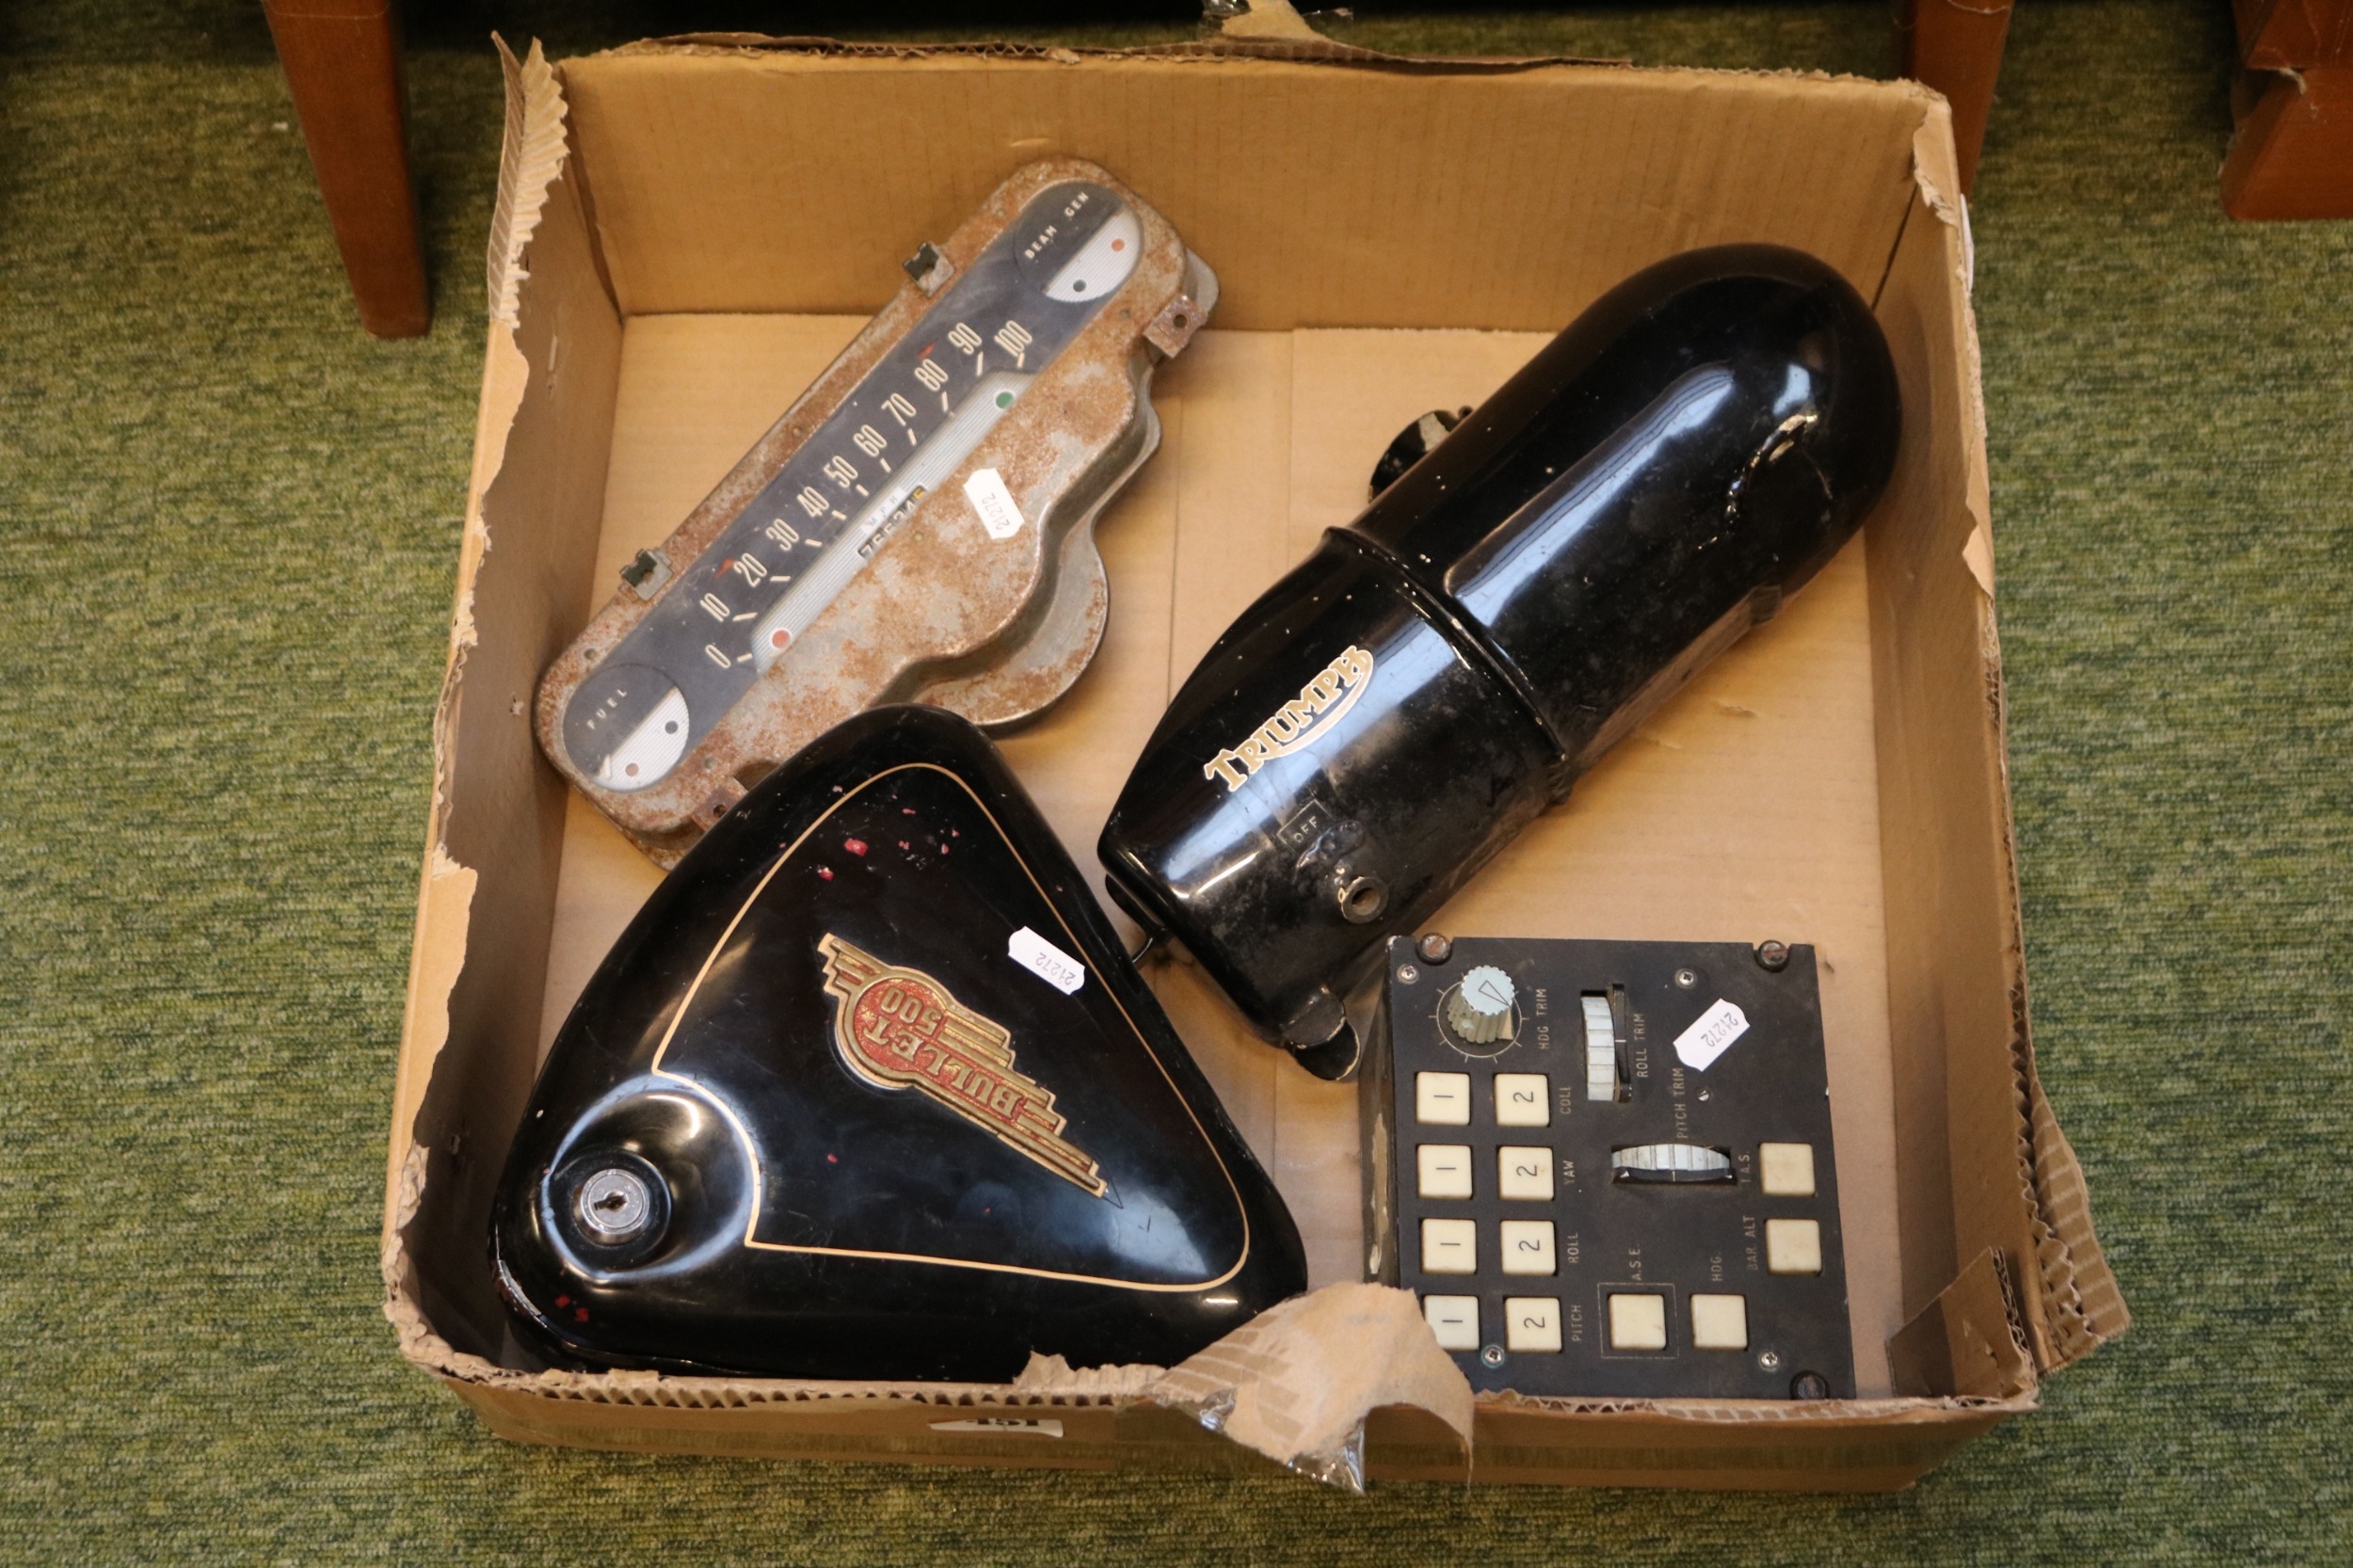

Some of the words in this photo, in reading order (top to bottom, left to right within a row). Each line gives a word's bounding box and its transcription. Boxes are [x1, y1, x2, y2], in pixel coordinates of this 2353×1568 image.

[1064, 191, 1089, 216] GEN
[1023, 225, 1057, 259] BEAM
[947, 322, 983, 355] 90
[993, 320, 1032, 357] 100
[914, 358, 949, 392] 80
[881, 392, 917, 426] 70
[853, 424, 888, 457] 60
[823, 455, 858, 488] 50
[796, 486, 829, 518] 40
[981, 492, 1011, 530] 21272
[765, 519, 799, 551] 30
[733, 552, 768, 587] 20
[699, 592, 730, 622] 10
[705, 644, 731, 669] 0
[586, 688, 628, 730] FUEL
[1204, 645, 1373, 792] TRIUMPH
[1292, 815, 1320, 845] OFF
[1034, 951, 1077, 986] 21272
[880, 986, 943, 1036] 500
[1535, 988, 1548, 1016] TRIM
[1633, 1012, 1646, 1042] TRIM
[1700, 1011, 1739, 1048] 21272
[863, 1016, 1025, 1119] BULLET
[1636, 1047, 1649, 1078] ROLL
[1513, 1090, 1535, 1103] 2
[1672, 1066, 1686, 1096] TRIM
[1559, 1084, 1573, 1115] COLL
[1674, 1102, 1689, 1139] PITCH
[1515, 1164, 1538, 1177] 2
[1562, 1160, 1576, 1186] YAW
[1742, 1214, 1757, 1239] ALT
[1518, 1239, 1541, 1252] 2
[1567, 1231, 1580, 1264] ROLL
[1523, 1316, 1545, 1329] 2
[1571, 1304, 1585, 1343] PITCH
